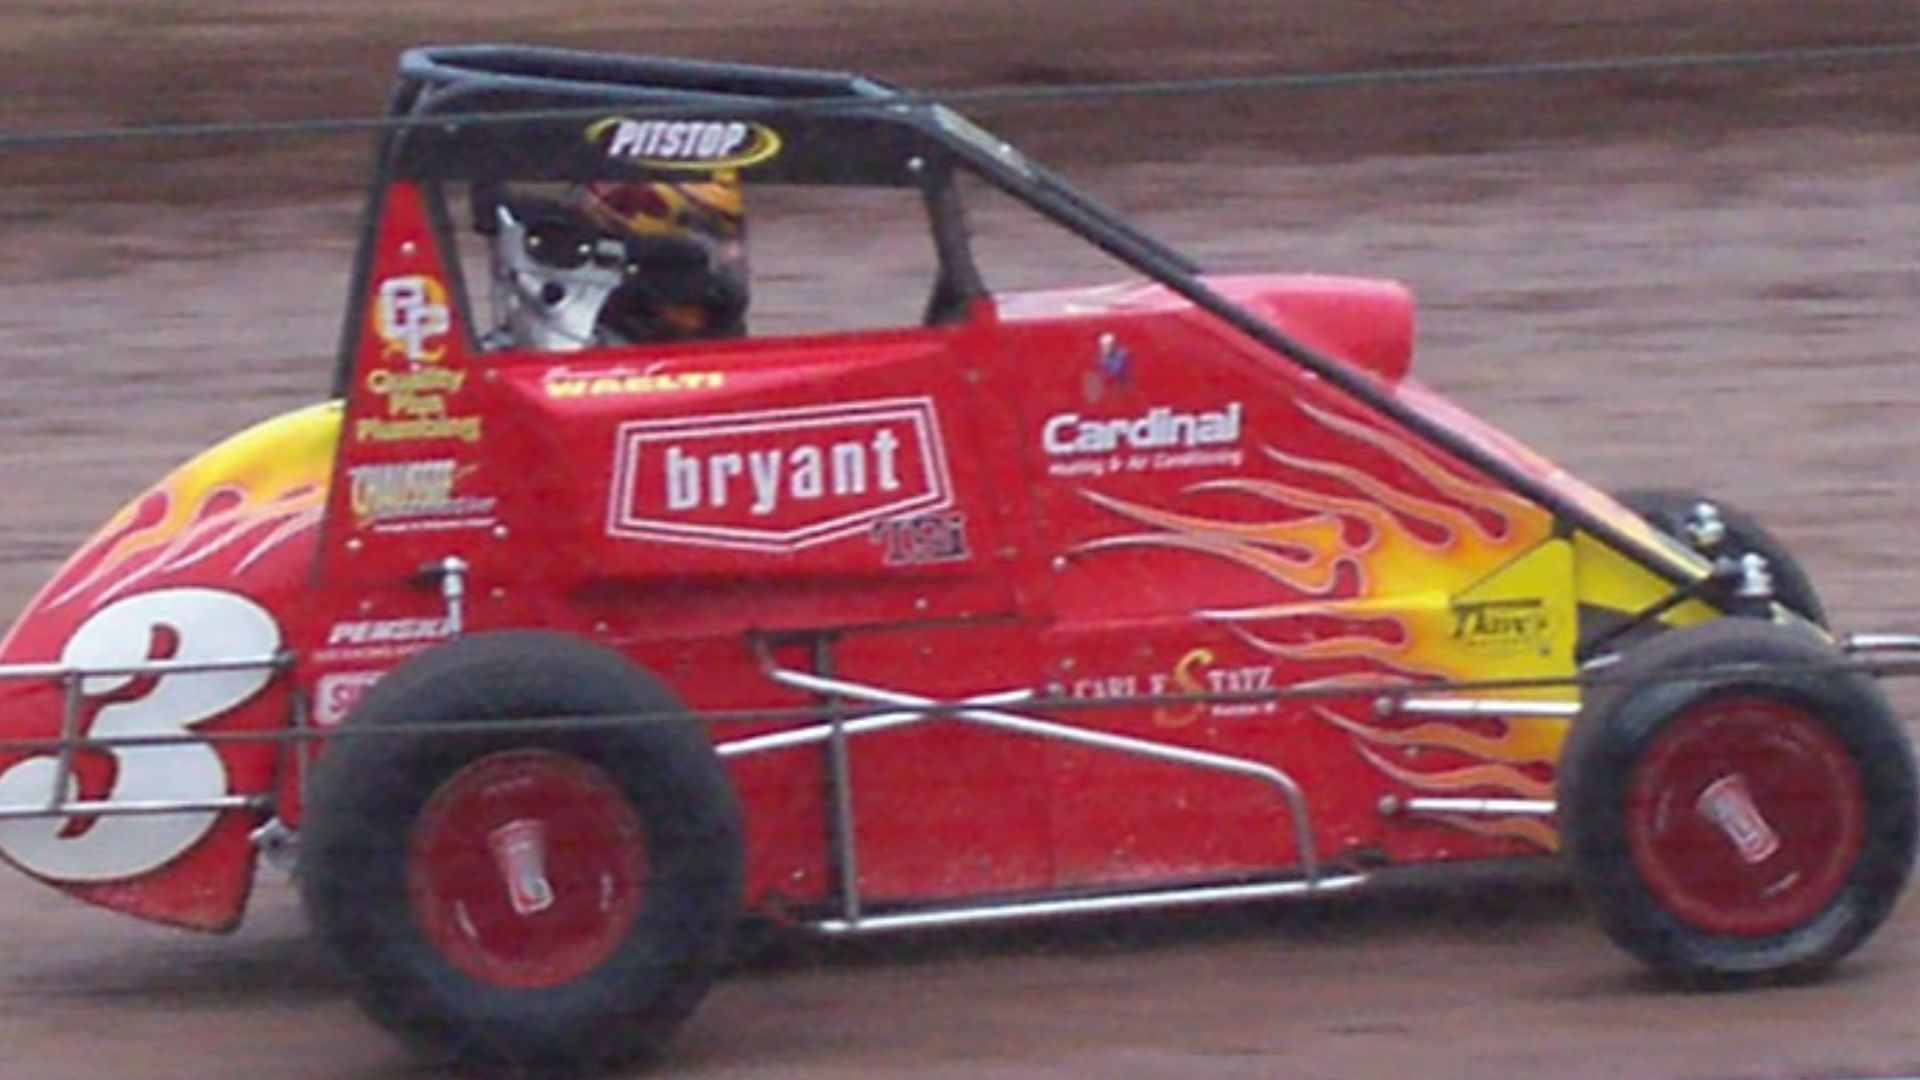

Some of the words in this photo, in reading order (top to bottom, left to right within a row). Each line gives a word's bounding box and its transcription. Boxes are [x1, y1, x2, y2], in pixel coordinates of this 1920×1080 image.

[608, 118, 747, 157] PITSTOP
[356, 416, 482, 442] Plumbing
[1042, 400, 1242, 454] Cardinal
[664, 428, 900, 514] bryant
[0, 588, 282, 882] 3
